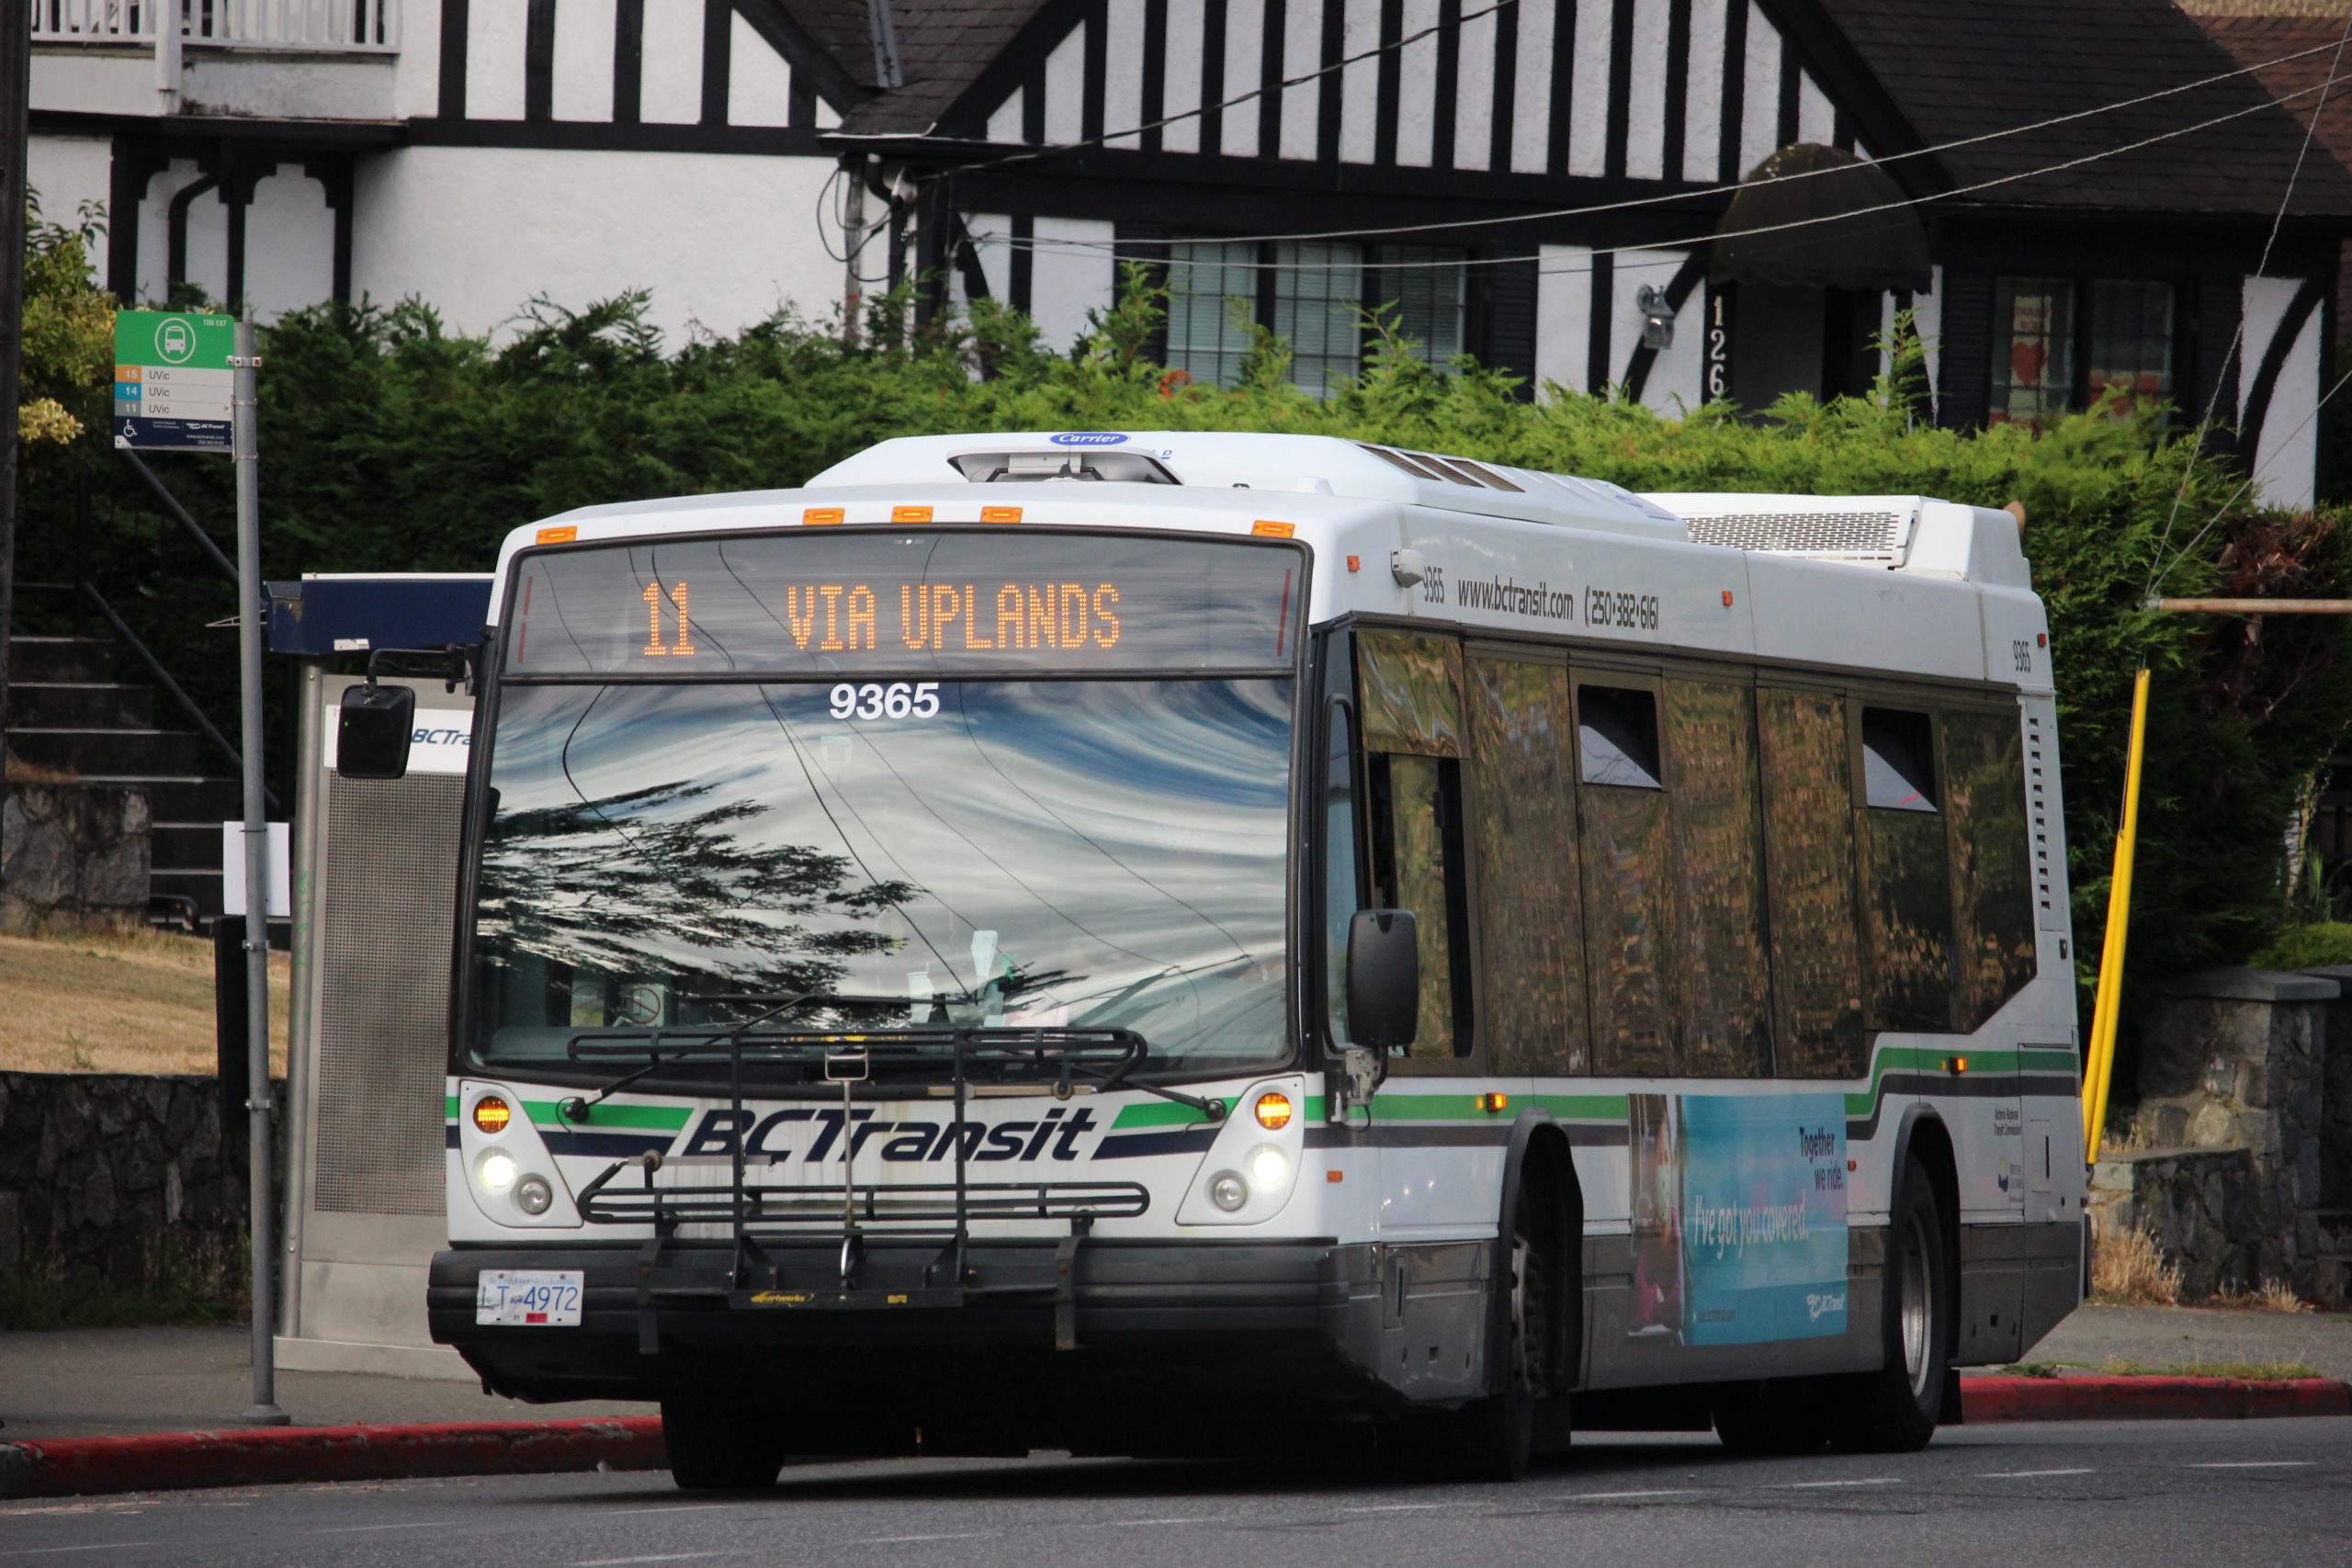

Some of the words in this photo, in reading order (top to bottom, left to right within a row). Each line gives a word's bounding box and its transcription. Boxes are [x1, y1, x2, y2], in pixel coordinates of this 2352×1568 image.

[126, 369, 138, 378] 15
[149, 370, 170, 380] UVic
[125, 386, 138, 396] 14
[149, 387, 170, 397] UVic
[125, 402, 137, 412] 11
[149, 404, 170, 414] UVic
[1058, 434, 1120, 444] Carrier
[1458, 575, 1574, 621] www.bctransit.com
[643, 581, 695, 656] 11
[787, 585, 875, 650] VIA
[901, 583, 1120, 649] UPLANDS
[2013, 639, 2031, 672] 9365
[830, 682, 940, 720] 9365
[1799, 1125, 1835, 1165] Together
[1815, 1168, 1826, 1190] we
[1827, 1159, 1844, 1190] ride.
[1694, 1194, 1716, 1246] I've
[1716, 1199, 1738, 1260] got
[1738, 1205, 1760, 1259] you
[1762, 1188, 1808, 1244] covered.
